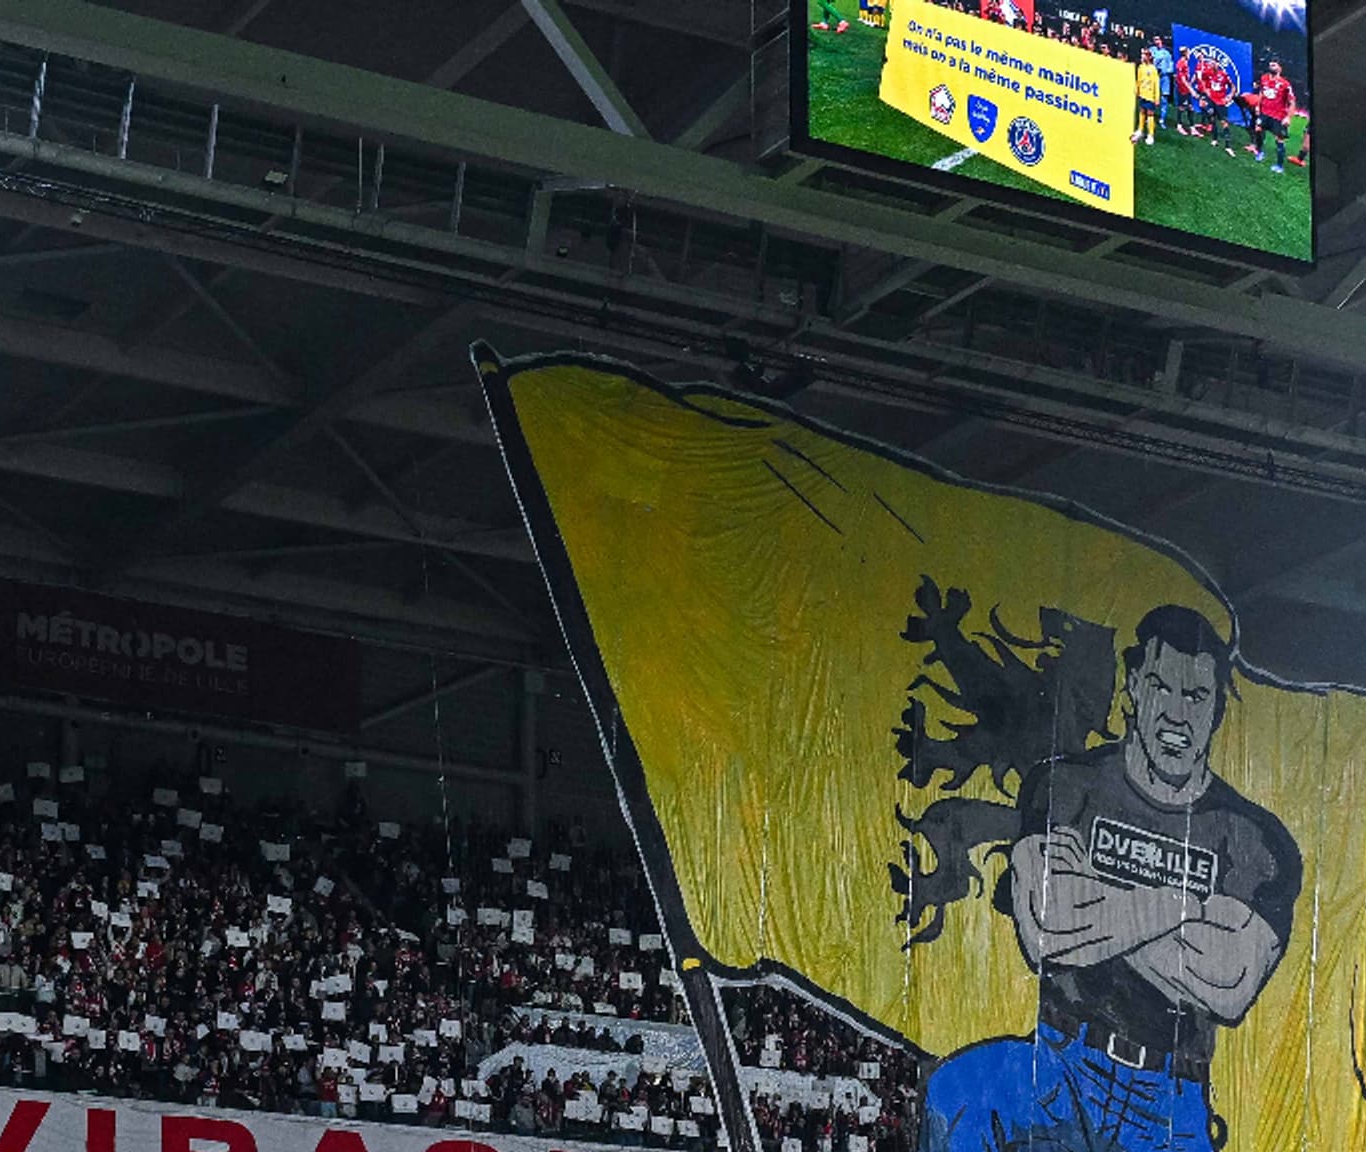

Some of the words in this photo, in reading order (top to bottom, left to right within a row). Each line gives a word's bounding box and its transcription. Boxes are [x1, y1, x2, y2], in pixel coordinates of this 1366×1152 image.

[902, 38, 929, 57] mais
[930, 49, 947, 64] on
[948, 55, 957, 69] a
[958, 57, 971, 74] la
[974, 65, 1022, 94] même
[1024, 83, 1094, 120] passion
[1095, 106, 1103, 124] !
[907, 20, 924, 35] On
[945, 35, 967, 52] pas
[970, 39, 983, 56] le
[985, 48, 1035, 75] même
[1038, 65, 1100, 98] maillot
[16, 609, 250, 672] MÉTROPOLE
